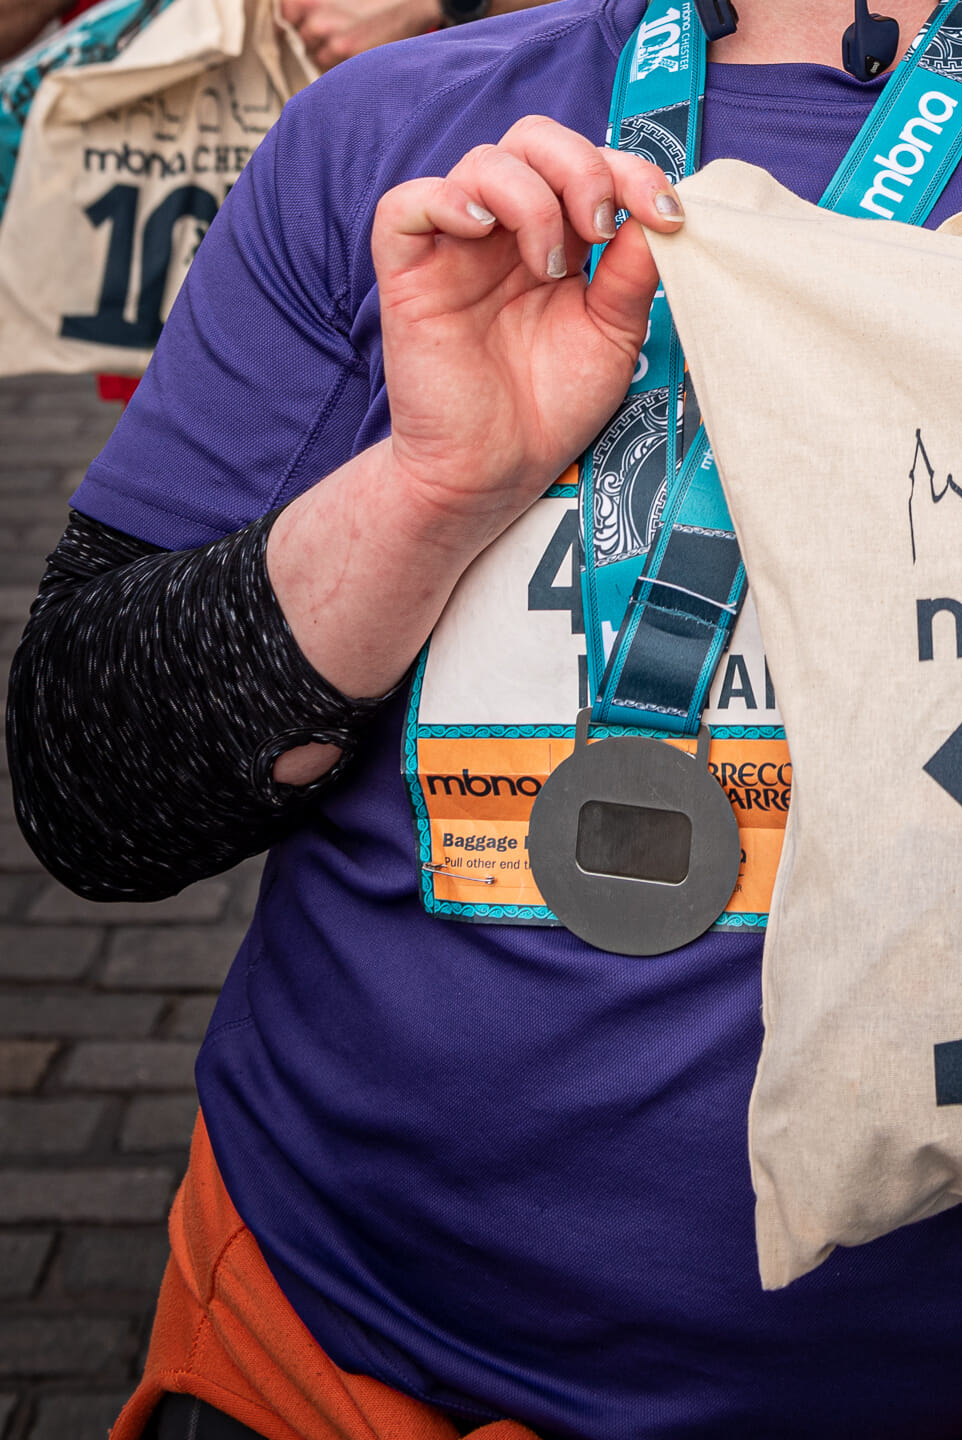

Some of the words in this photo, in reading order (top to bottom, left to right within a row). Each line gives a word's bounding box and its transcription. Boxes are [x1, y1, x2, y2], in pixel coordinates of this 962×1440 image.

[682, 1, 691, 32] mbna
[629, 7, 681, 82] 10K
[680, 33, 691, 71] CHESTER
[84, 143, 187, 179] mbna
[859, 90, 958, 220] mbna
[59, 182, 234, 351] 10
[443, 833, 518, 853] Baggage
[444, 857, 463, 869] Pull
[466, 858, 496, 869] other
[499, 860, 520, 870] end
